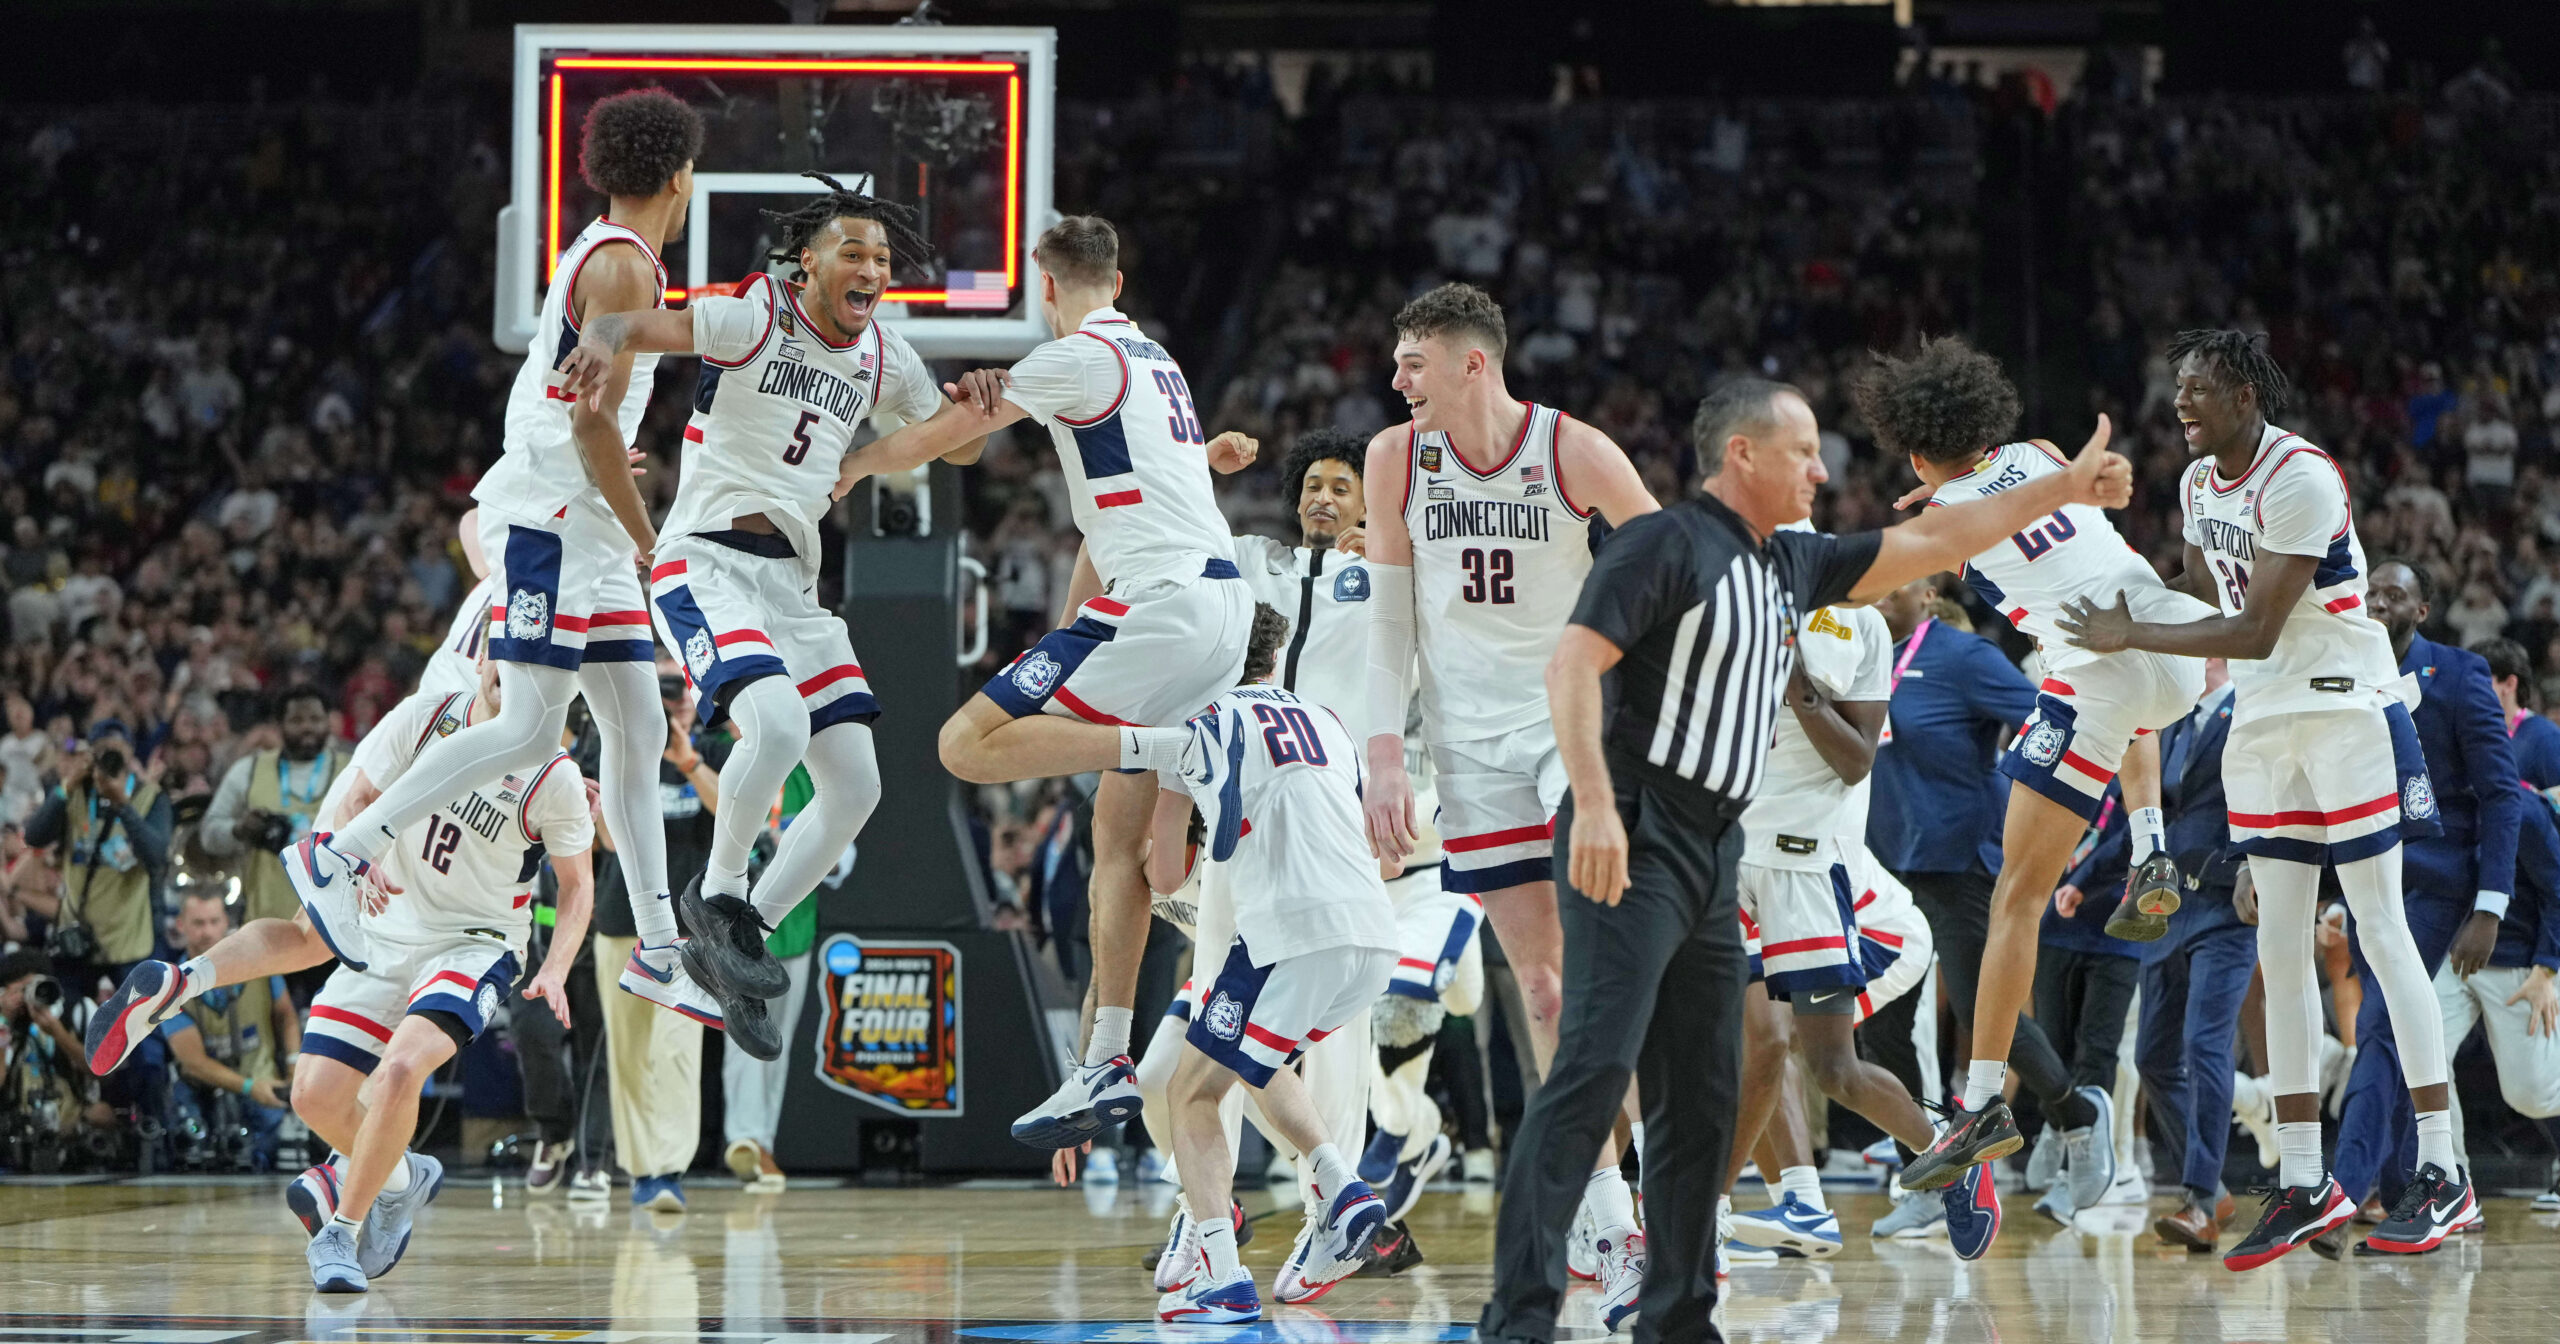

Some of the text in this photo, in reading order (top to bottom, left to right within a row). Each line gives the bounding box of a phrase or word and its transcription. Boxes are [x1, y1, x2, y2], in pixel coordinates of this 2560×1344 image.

[758, 360, 863, 427] CONNECTICUT
[1152, 369, 1204, 445] 33
[782, 410, 820, 466] 5
[1425, 500, 1550, 542] CONNECTICUT
[1461, 548, 1515, 605] 32
[1251, 703, 1328, 768] 20
[421, 813, 462, 876] 12
[841, 973, 932, 1009] FINAL
[841, 1008, 931, 1043] FOUR
